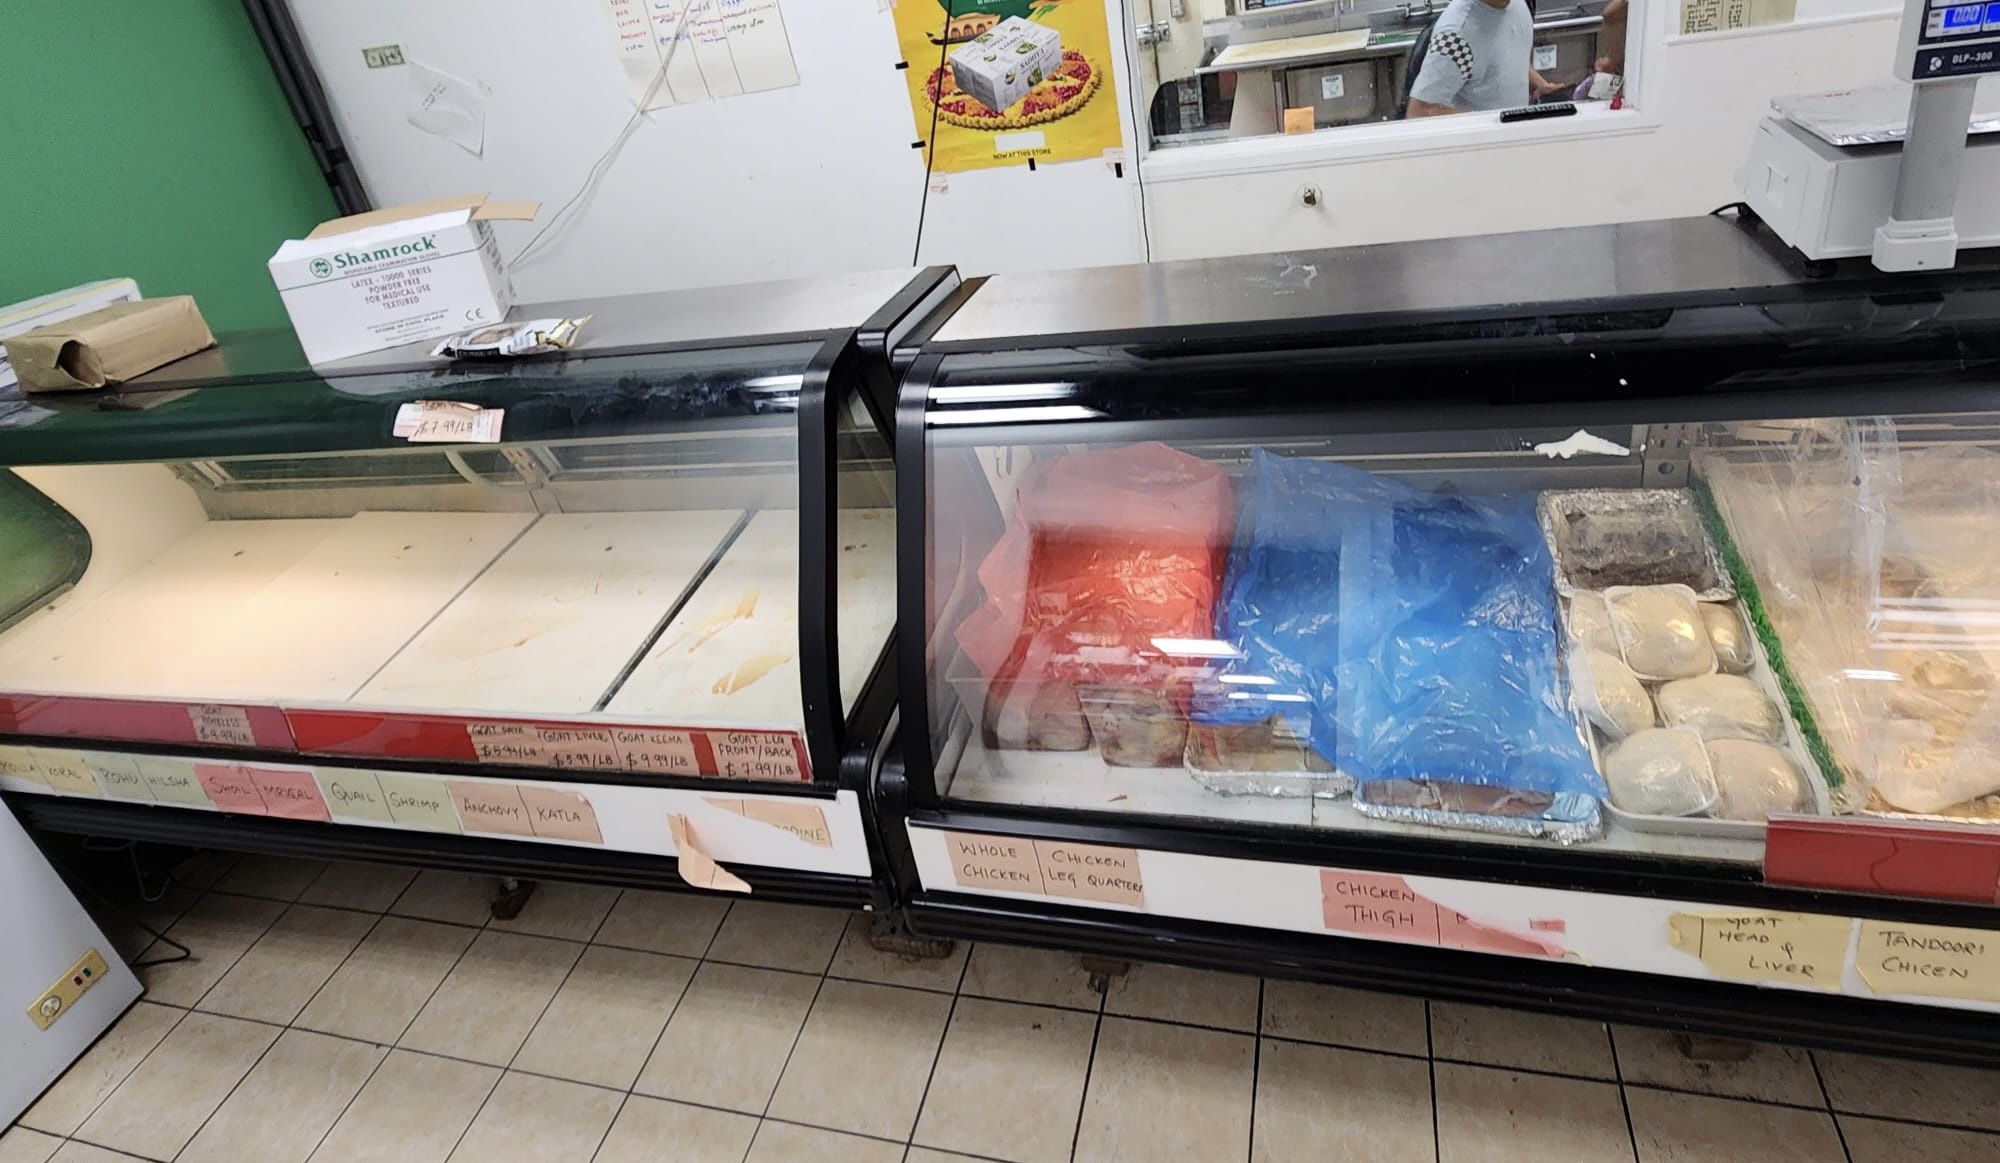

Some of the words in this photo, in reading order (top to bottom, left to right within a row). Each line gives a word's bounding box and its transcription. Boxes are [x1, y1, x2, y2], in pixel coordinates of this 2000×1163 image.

[993, 152, 1008, 160] NOW
[1016, 150, 1031, 158] THIS
[1031, 148, 1051, 156] STORE
[334, 235, 436, 269] Shamrock
[351, 278, 374, 289] LATEX
[407, 265, 432, 277] SERIES
[369, 281, 402, 294] POWDER
[404, 277, 421, 288] FREE
[365, 294, 380, 304] FOR
[382, 288, 415, 302] MEDICAL
[416, 283, 431, 295] USE
[382, 296, 420, 310] TEXTURED
[617, 732, 645, 744] GOAT
[728, 733, 757, 746] GOAT
[331, 781, 375, 806] QUAIL
[388, 791, 440, 813] SHRIMP
[463, 797, 520, 822] ANCHOVY
[537, 806, 582, 824] KATLA
[959, 841, 1017, 859] WHOLE
[1051, 850, 1126, 869] CHICKEN
[962, 863, 1030, 883] CHICKEN
[1048, 867, 1077, 889] LEG
[1086, 874, 1144, 894] QUARTERS
[1336, 880, 1416, 903] CHICKEN
[1344, 904, 1415, 930] THIGH
[1718, 931, 1770, 944] HEAD
[1879, 930, 1986, 955] TANDOORI
[1749, 956, 1815, 979] LIVER
[1881, 957, 1970, 980] CHICEN
